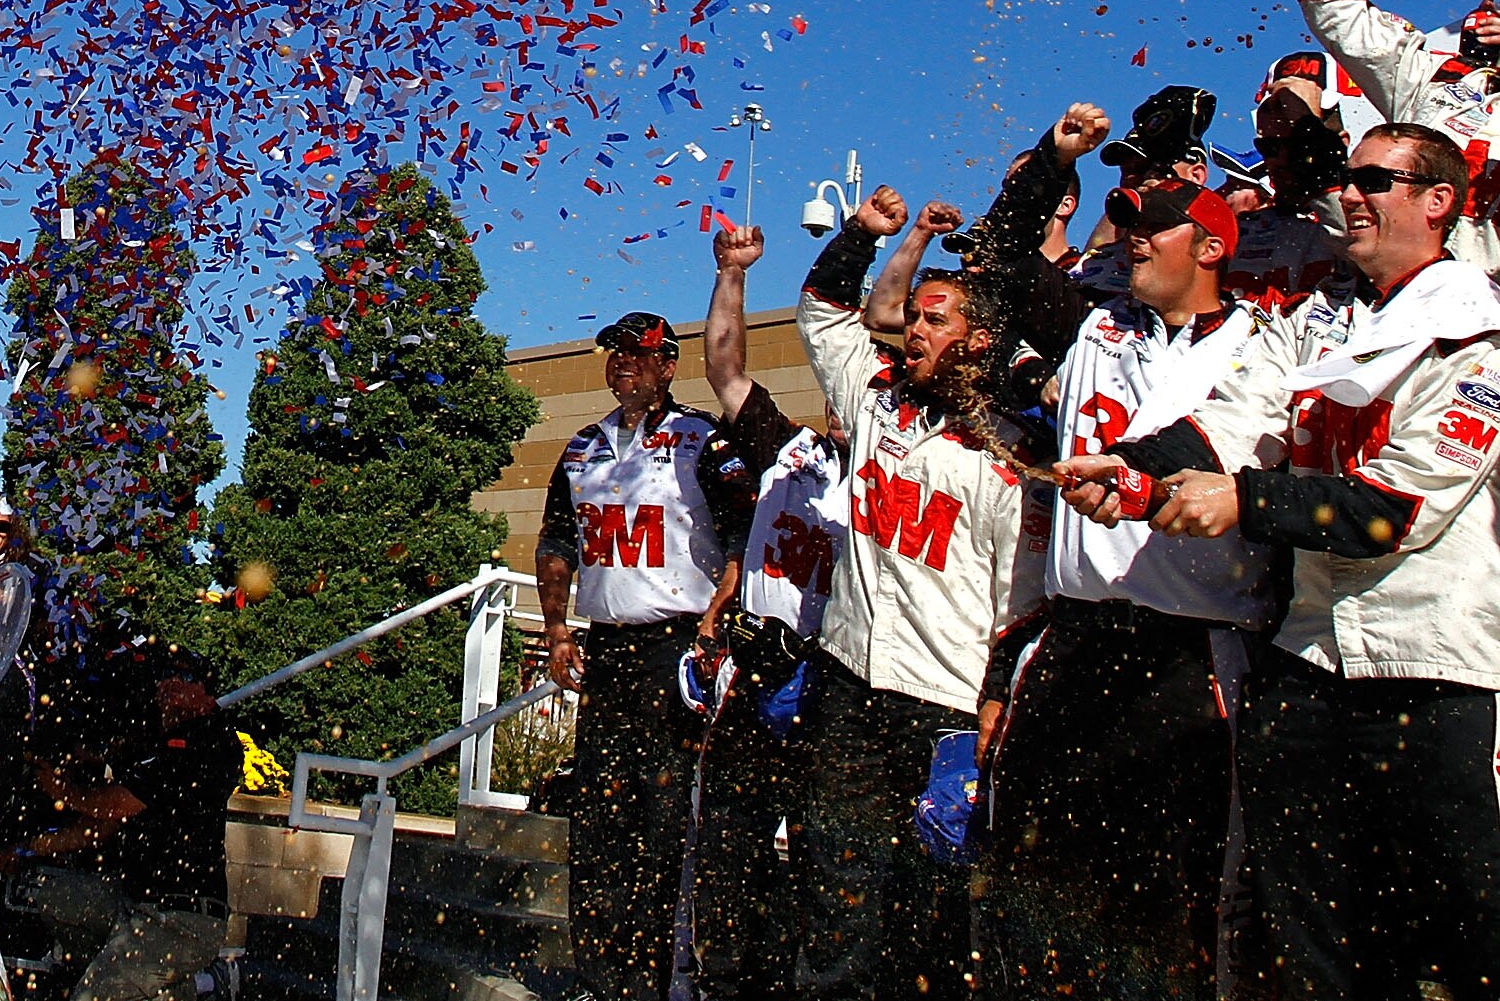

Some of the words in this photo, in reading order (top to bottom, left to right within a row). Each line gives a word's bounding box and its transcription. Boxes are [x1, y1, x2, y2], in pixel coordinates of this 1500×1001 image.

[1281, 59, 1320, 77] 3M
[1436, 410, 1499, 456] 3M
[1438, 445, 1479, 468] SIMPSON
[575, 502, 666, 568] 3M
[852, 458, 964, 573] 3M
